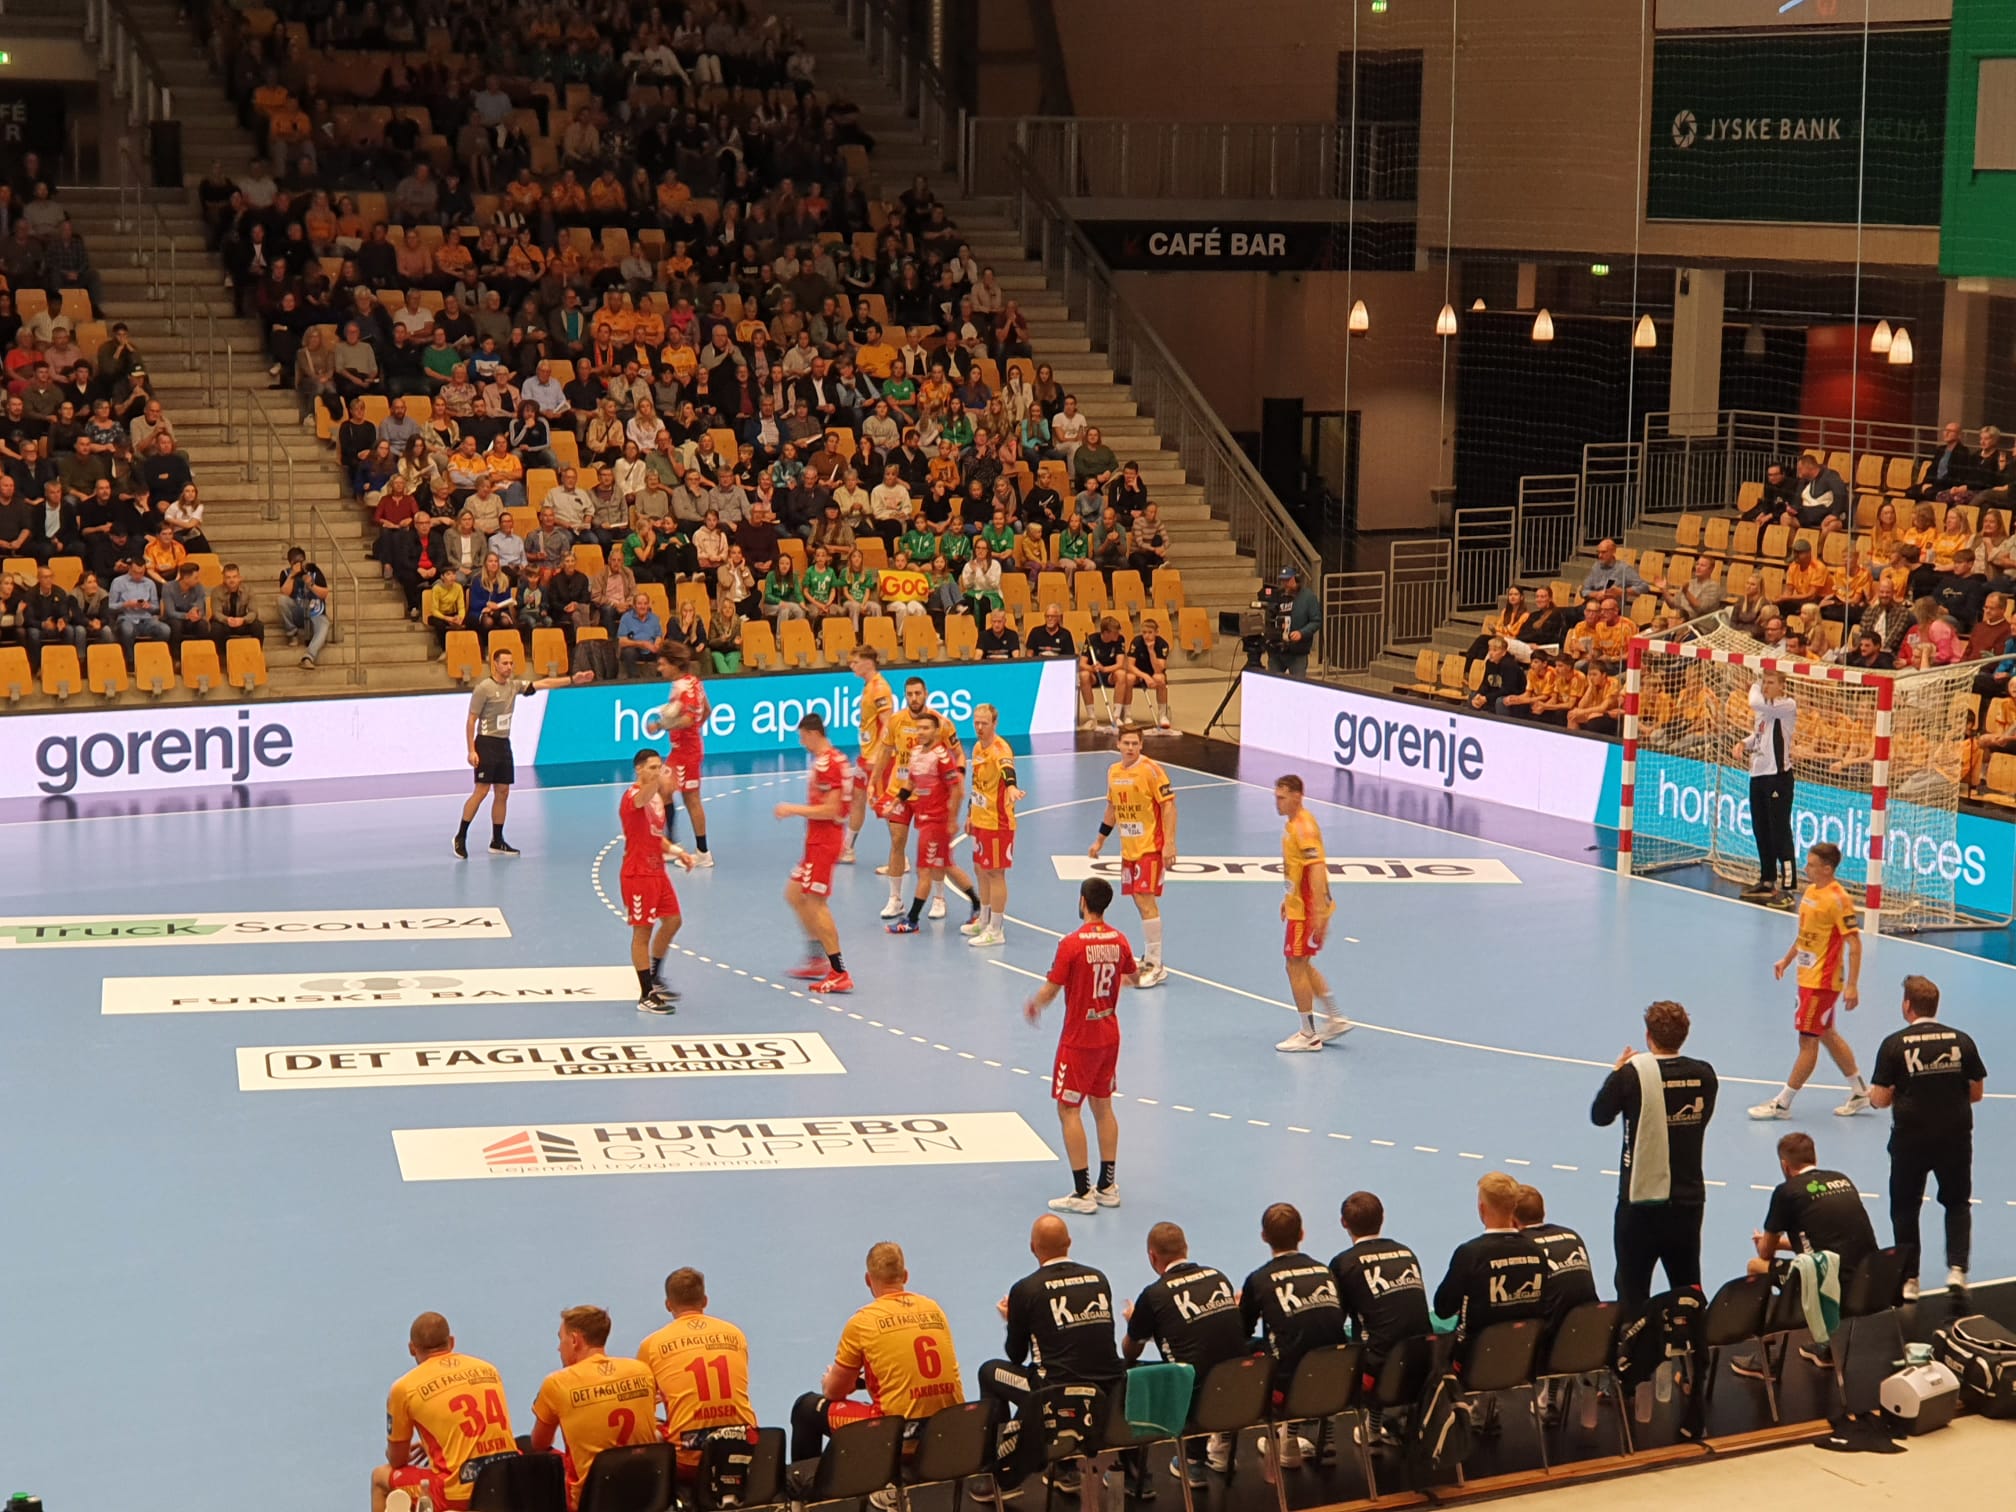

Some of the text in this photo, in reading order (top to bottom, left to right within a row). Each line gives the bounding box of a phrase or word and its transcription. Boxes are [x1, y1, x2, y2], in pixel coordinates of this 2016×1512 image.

[1704, 118, 1771, 140] JYSKE
[1779, 117, 1841, 140] BANK
[1149, 227, 1286, 256] CAFÉ BAR
[614, 699, 736, 742] hoe
[36, 710, 293, 794] gorenje
[1334, 711, 1484, 787] gorenje
[19, 917, 500, 938] Truck Scout24
[432, 987, 595, 998] BANK
[1093, 963, 1115, 999] 18
[285, 1042, 786, 1070] DET FAGLIGE HUS
[561, 1060, 777, 1075] FORSIKRING
[593, 1119, 949, 1143] HUMLEBO
[602, 1136, 963, 1161] GRUPPEN
[879, 1317, 898, 1329] DET
[661, 1340, 679, 1355] DET
[681, 1334, 720, 1348] FAGLIGE
[723, 1333, 739, 1345] HUS
[913, 1335, 942, 1379] 6
[420, 1380, 441, 1397] DET
[441, 1368, 480, 1387] FAGLIGE
[572, 1388, 591, 1403] DET
[593, 1379, 632, 1399] FAGLIGE
[684, 1354, 732, 1403] 11
[448, 1388, 507, 1438] 34
[694, 1404, 737, 1420] MADSEN
[607, 1407, 636, 1447] 2
